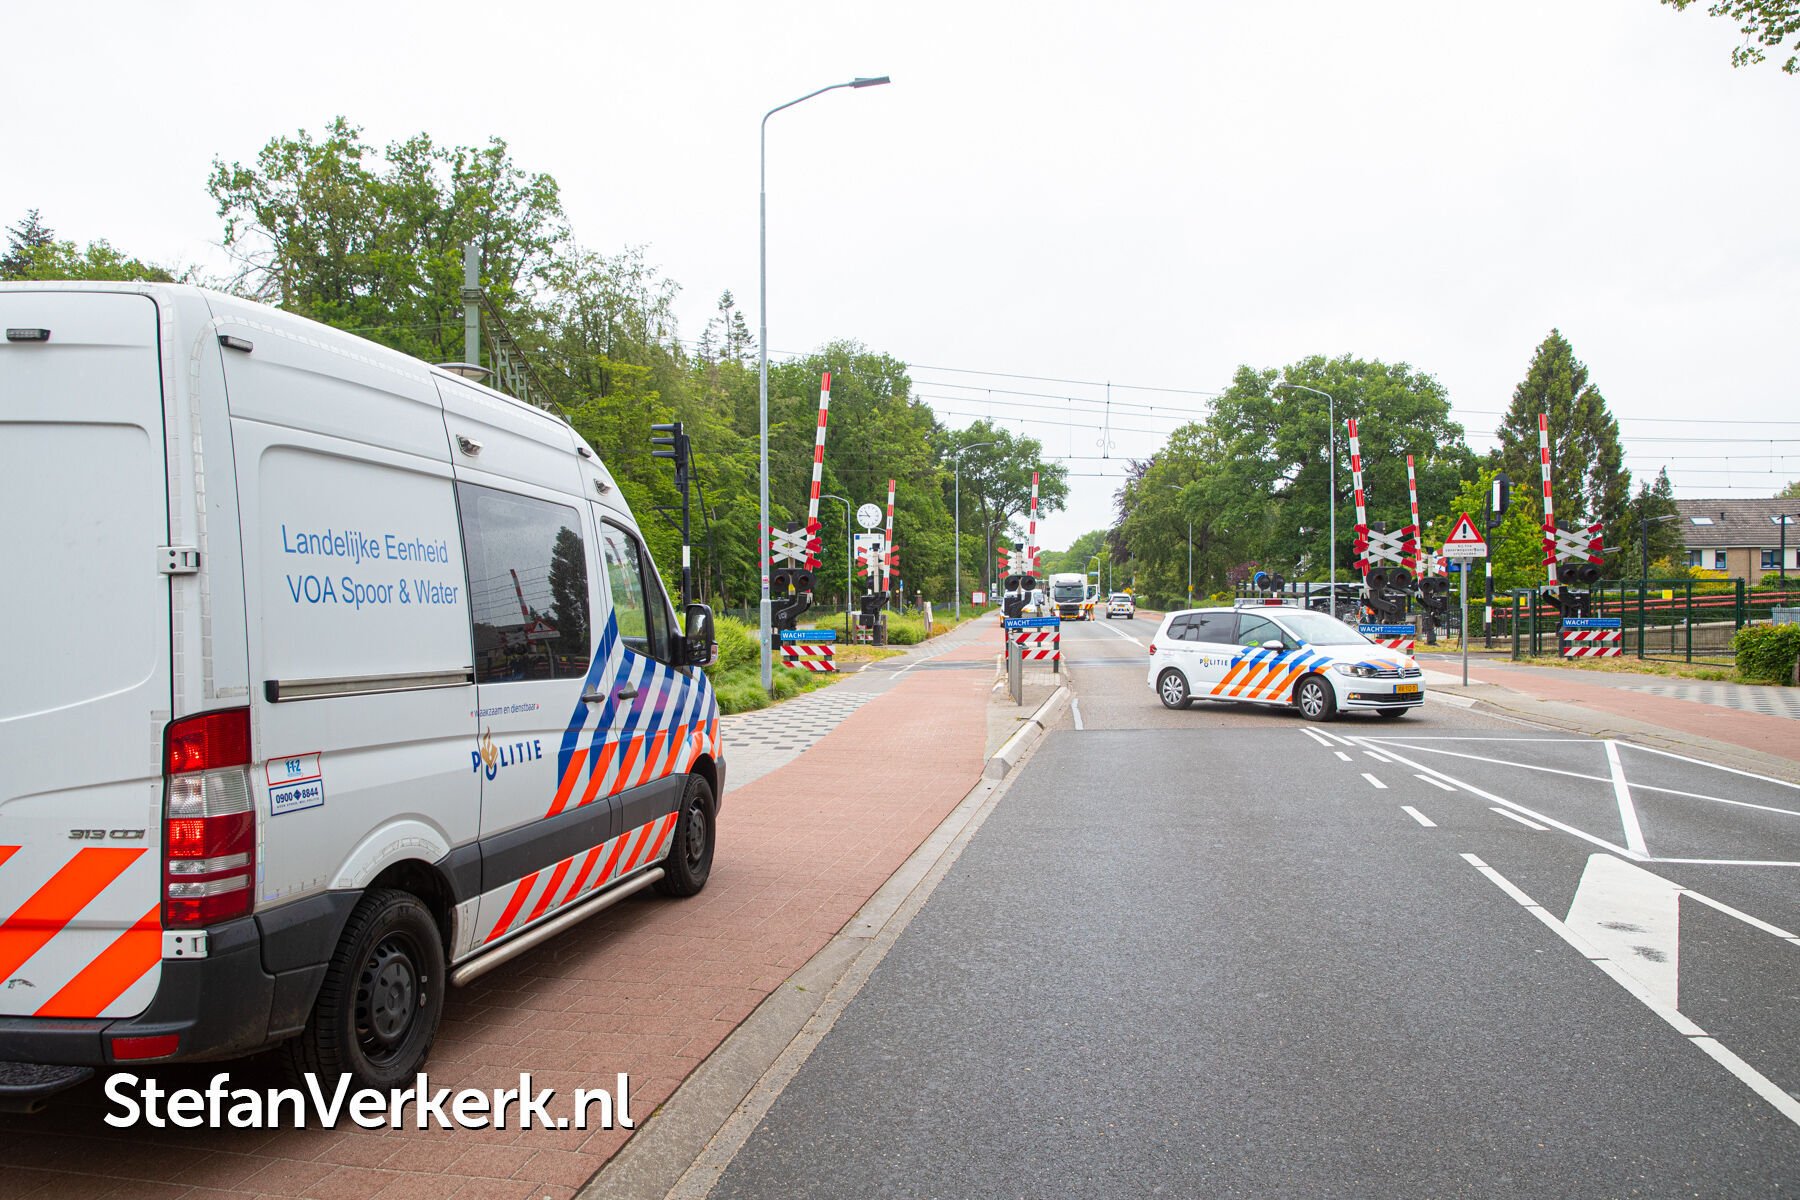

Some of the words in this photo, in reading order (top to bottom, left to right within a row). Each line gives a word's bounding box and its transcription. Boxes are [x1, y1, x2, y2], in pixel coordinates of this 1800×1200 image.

[282, 524, 380, 565] Landelijke
[384, 534, 449, 564] Eenheid
[286, 574, 338, 604] VOA
[341, 576, 394, 611] Spoor
[399, 578, 411, 604] &
[414, 579, 459, 605] Water
[1006, 619, 1031, 627] WACHT
[1199, 658, 1228, 667] POLITIE
[471, 739, 543, 781] POLITIE
[275, 791, 294, 804] 0900
[301, 786, 319, 799] 8844
[68, 829, 106, 840] 313
[109, 828, 146, 840] CDI
